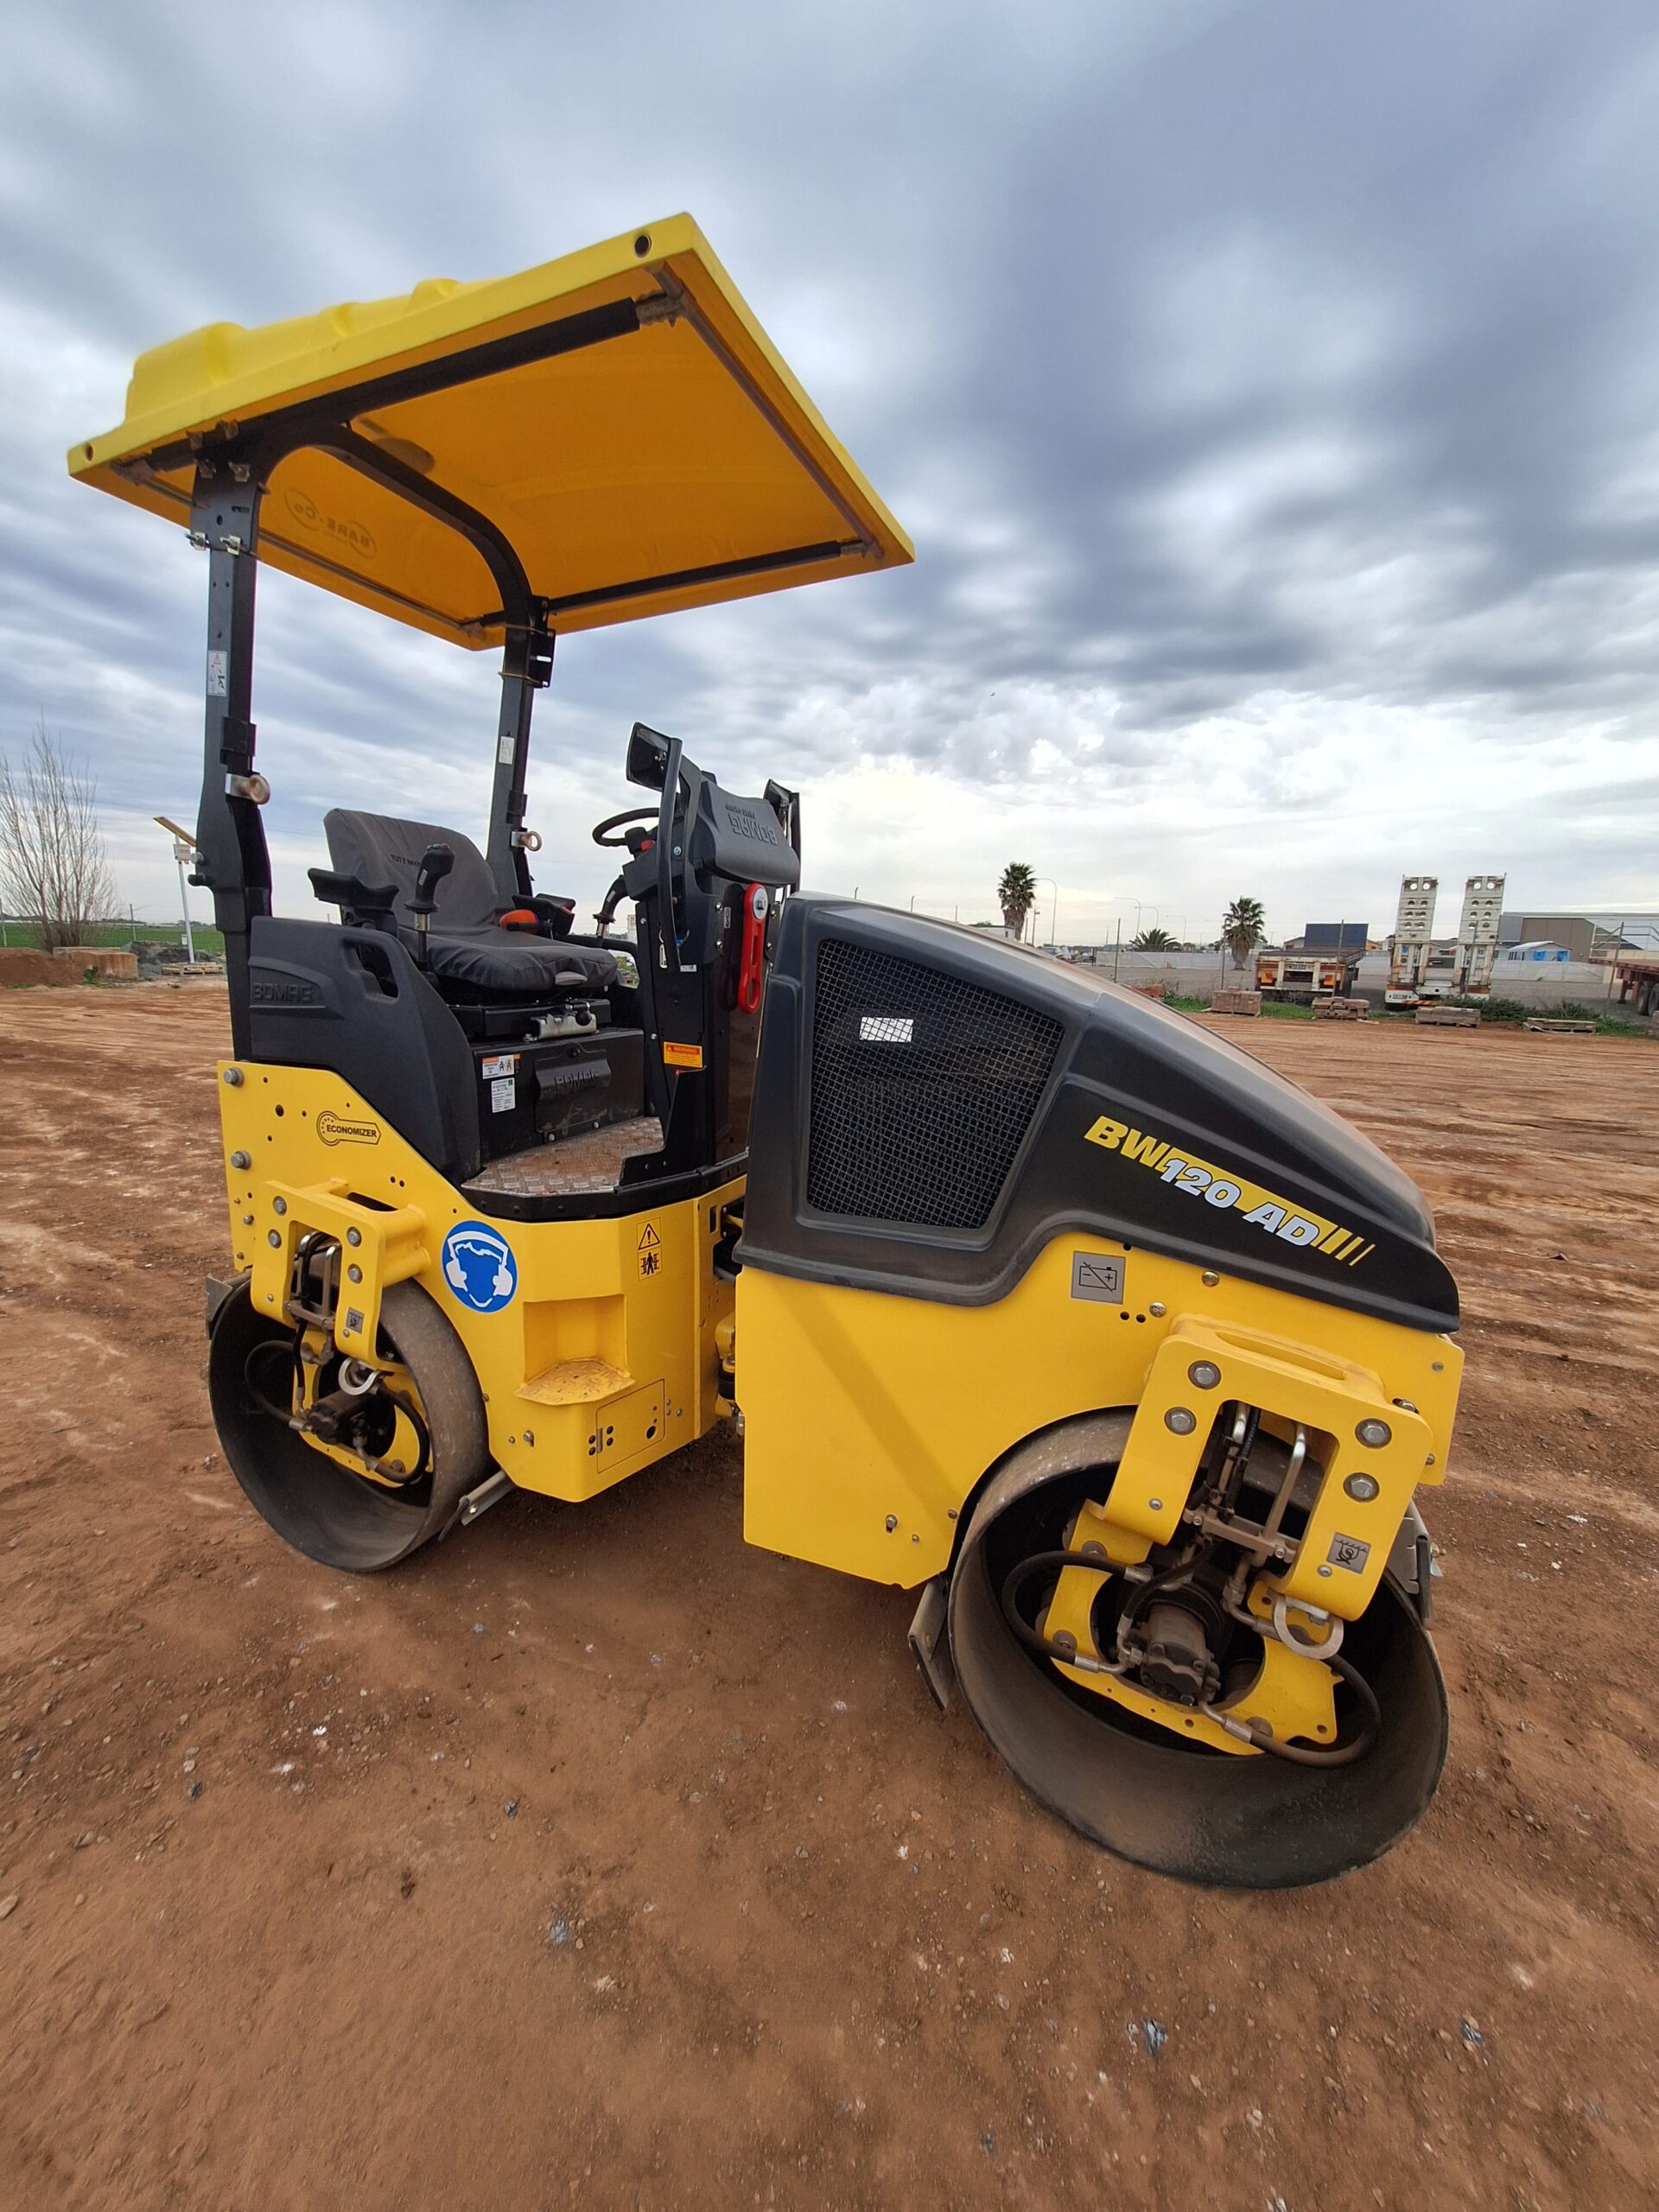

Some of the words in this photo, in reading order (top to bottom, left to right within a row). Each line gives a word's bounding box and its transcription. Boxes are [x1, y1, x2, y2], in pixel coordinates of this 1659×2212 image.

[728, 813, 779, 846] BOMAG
[252, 982, 313, 1003] BOMAG
[326, 1124, 378, 1138] ECONOMIZER
[1242, 1202, 1320, 1246] AD
